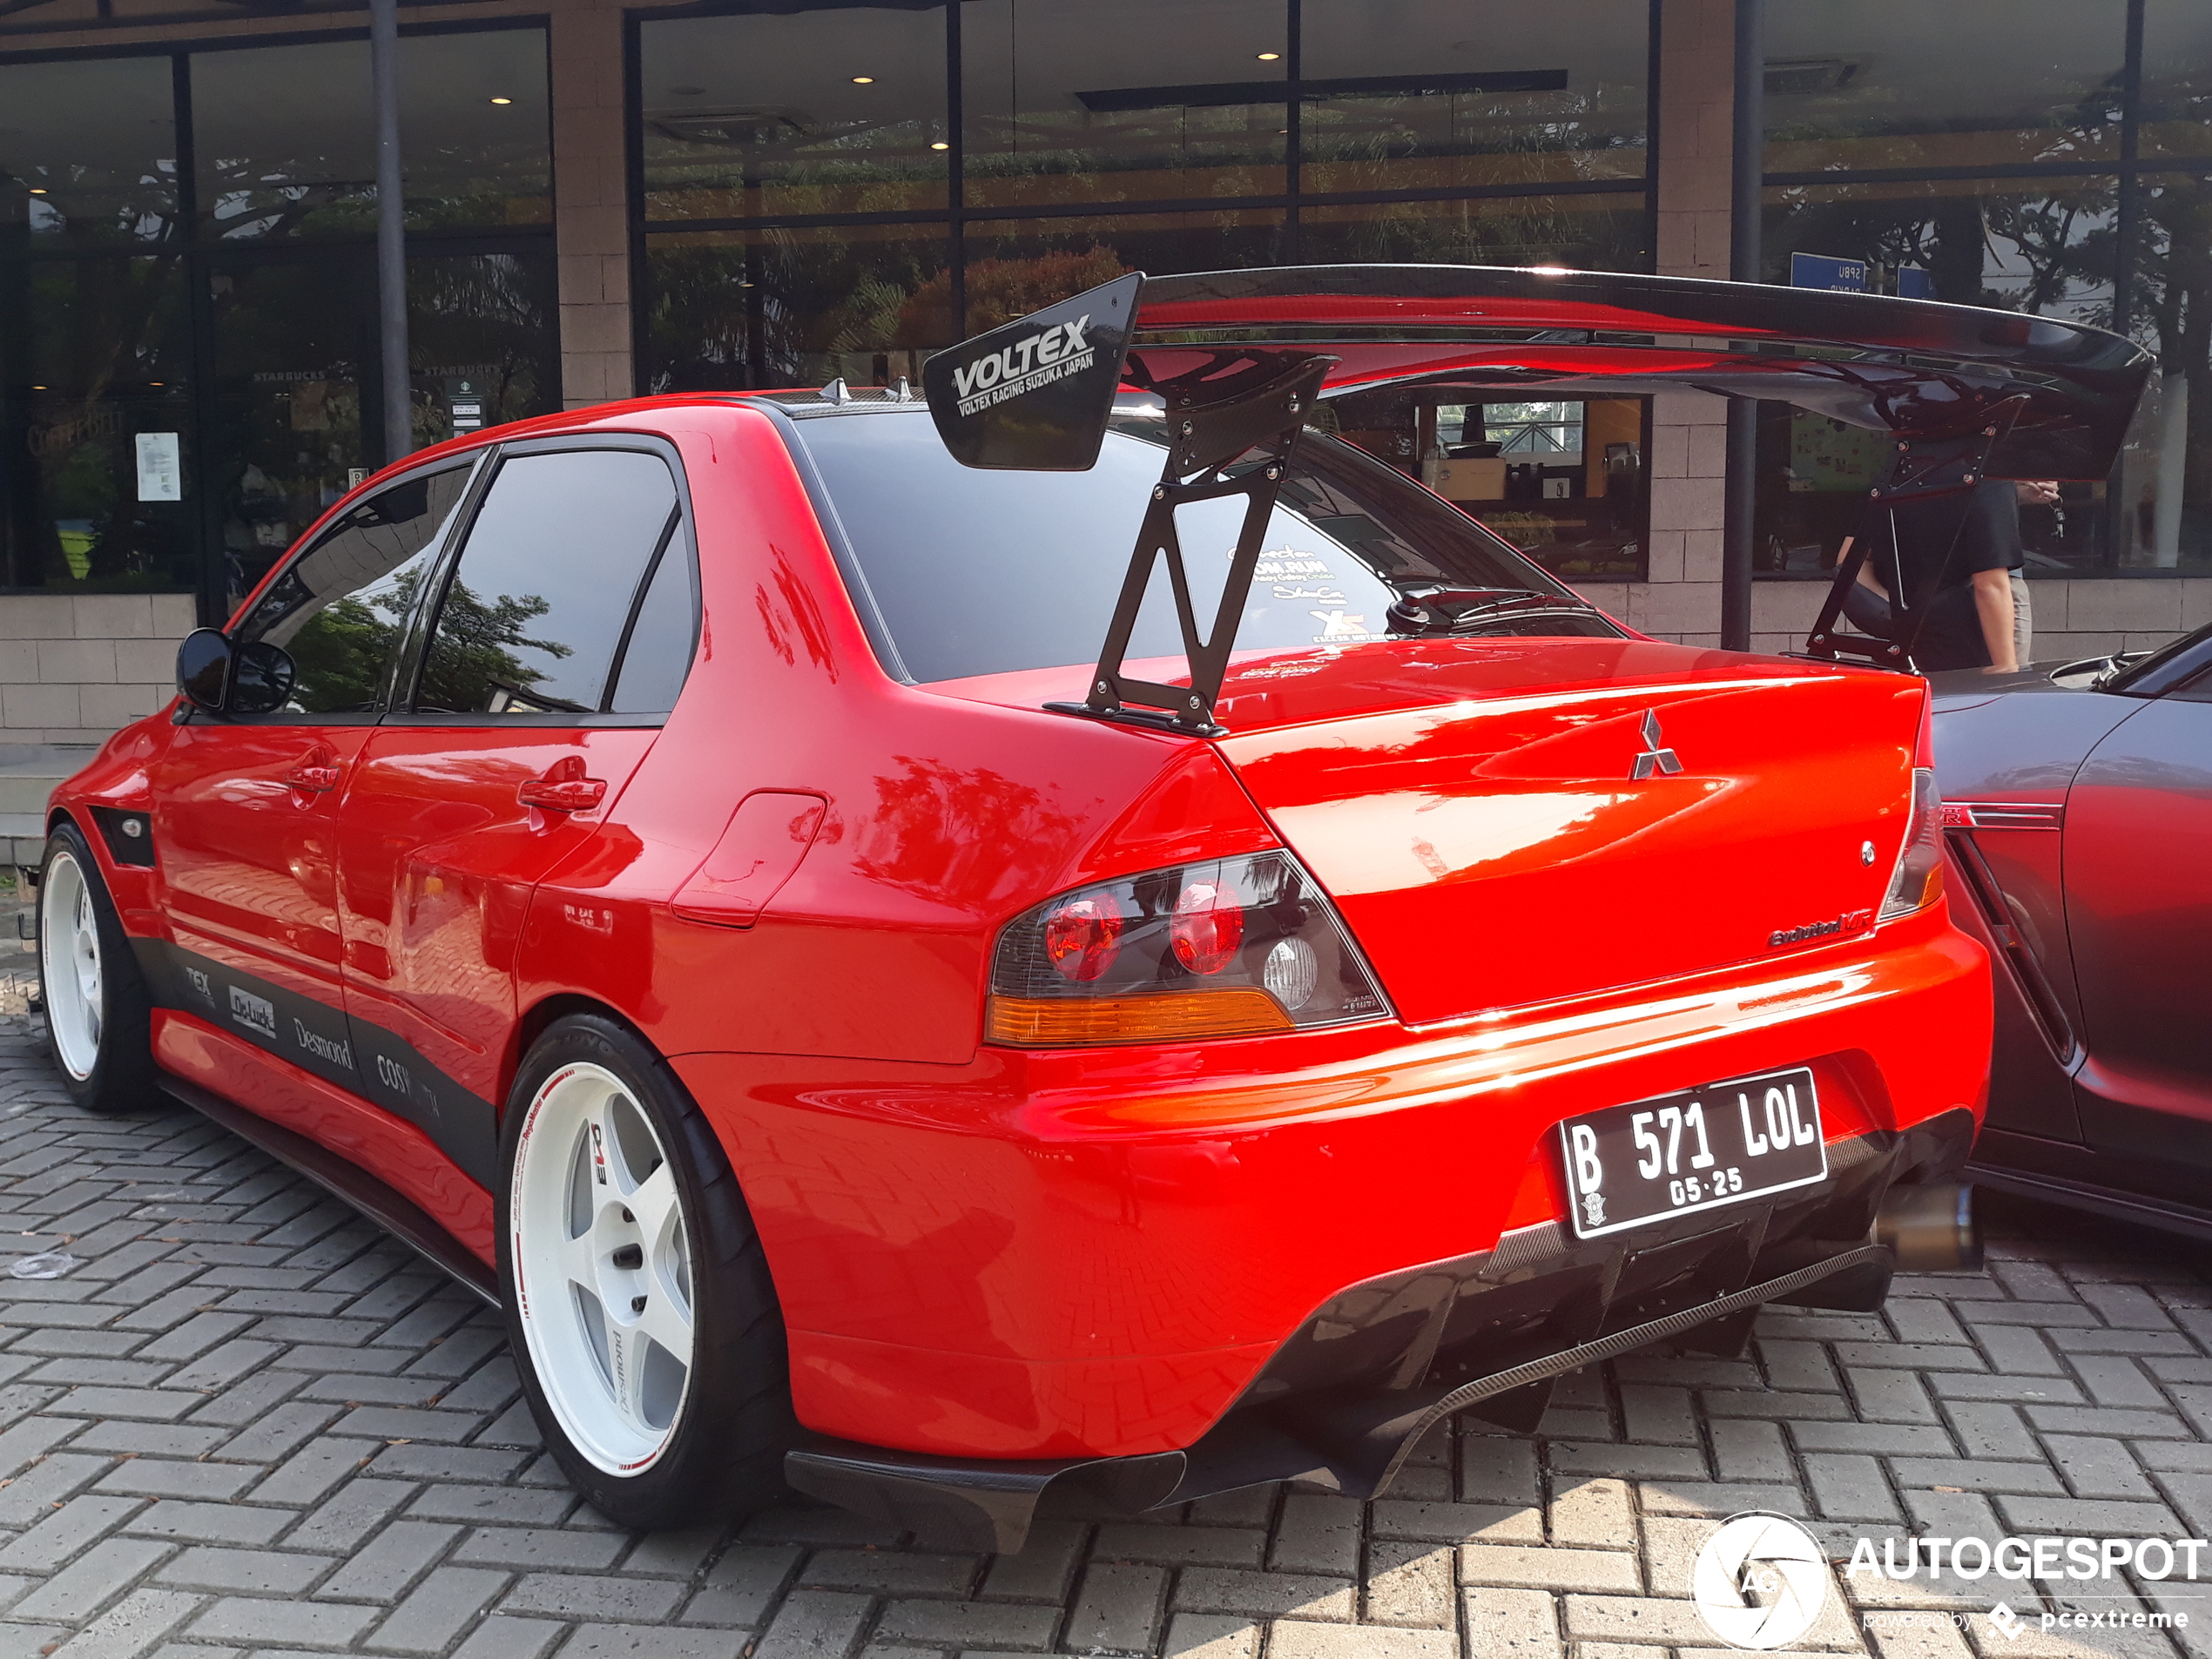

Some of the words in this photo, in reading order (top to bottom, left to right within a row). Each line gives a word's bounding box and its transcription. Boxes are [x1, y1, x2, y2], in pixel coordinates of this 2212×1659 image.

[253, 371, 326, 381] STARBUCKS
[423, 364, 501, 376] STARBUCKS
[954, 314, 1090, 398] VOLTEX
[959, 393, 991, 418] VOLTEX
[992, 381, 1025, 405] RACING
[1025, 367, 1062, 392] SUZUKA
[1063, 353, 1094, 376] JAPAN
[1312, 634, 1350, 643] EXCESS
[1352, 632, 1399, 642] MOTORING
[293, 1017, 354, 1070] Desmond
[1571, 1123, 1602, 1195] B
[1631, 1102, 1716, 1180] 571
[1737, 1083, 1814, 1157] LOL
[611, 1329, 631, 1416] Desmond
